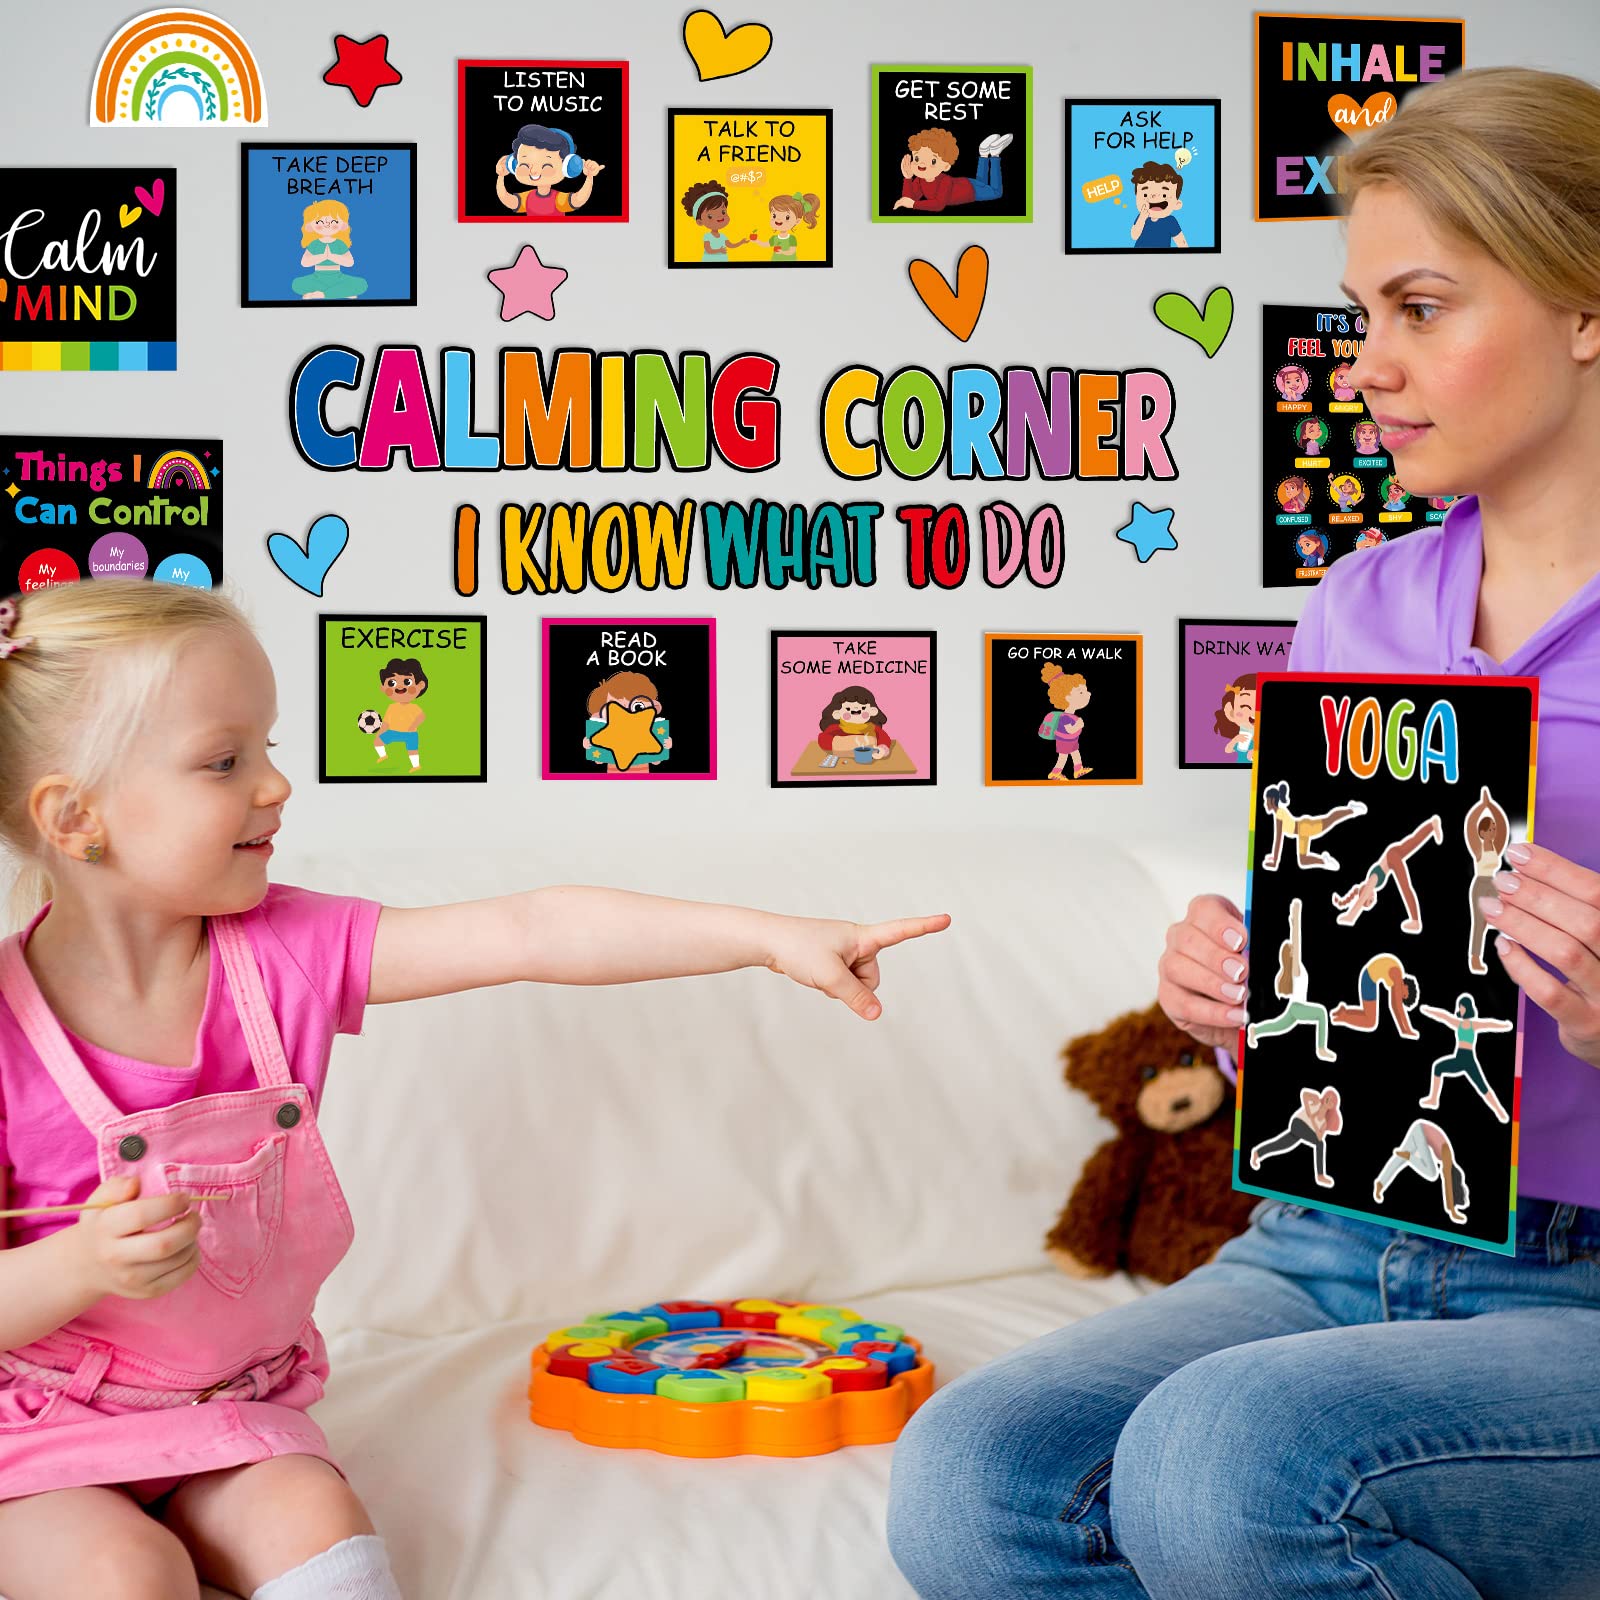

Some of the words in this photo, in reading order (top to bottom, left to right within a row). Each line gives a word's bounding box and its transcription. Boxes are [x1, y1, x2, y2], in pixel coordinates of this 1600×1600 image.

[1282, 41, 1446, 83] INHALE
[503, 71, 585, 89] LISTEN
[895, 79, 940, 99] GET
[946, 80, 1012, 100] SOME
[493, 95, 524, 112] TO
[530, 95, 603, 112] MUSIC
[925, 102, 984, 121] REST
[1334, 97, 1394, 128] and
[1120, 110, 1162, 128] ASK
[703, 120, 758, 138] TALK
[765, 120, 795, 138] TO
[1094, 132, 1136, 149] FOR
[1143, 131, 1193, 149] HELP
[697, 146, 710, 162] A
[719, 145, 801, 162] FRIEND
[272, 156, 328, 173] TAKE
[336, 156, 388, 173] DEEP
[287, 178, 373, 195] BREATH
[1086, 180, 1120, 199] HELP
[0, 209, 158, 280] Calm
[14, 285, 137, 321] MIND
[1316, 312, 1350, 333] IT'S
[1287, 337, 1326, 357] FEEL
[1331, 338, 1365, 358] YOU
[289, 344, 780, 472] CALMING
[820, 364, 1179, 481] CORNER
[15, 450, 123, 492] Things
[133, 454, 142, 482] I
[15, 495, 78, 525] Can
[88, 495, 209, 526] Control
[110, 546, 125, 559] My
[454, 503, 480, 597] I
[499, 498, 697, 595] KNOW
[701, 499, 884, 590] WHAT
[896, 502, 970, 589] TO
[979, 502, 1065, 589] DO
[38, 563, 57, 578] My
[92, 561, 145, 572] boundaries
[171, 567, 190, 582] My
[341, 627, 467, 649] EXERCISE
[601, 631, 657, 648] READ
[833, 641, 877, 655] TAKE
[1007, 647, 1029, 659] GO
[1033, 647, 1062, 659] FOR
[1066, 648, 1077, 659] A
[1082, 647, 1122, 660] WALK
[1193, 640, 1251, 655] DRINK
[586, 651, 600, 666] A
[608, 650, 667, 666] BOOK
[780, 660, 832, 674] SOME
[837, 660, 928, 674] MEDICINE
[1320, 695, 1459, 784] YOGA
